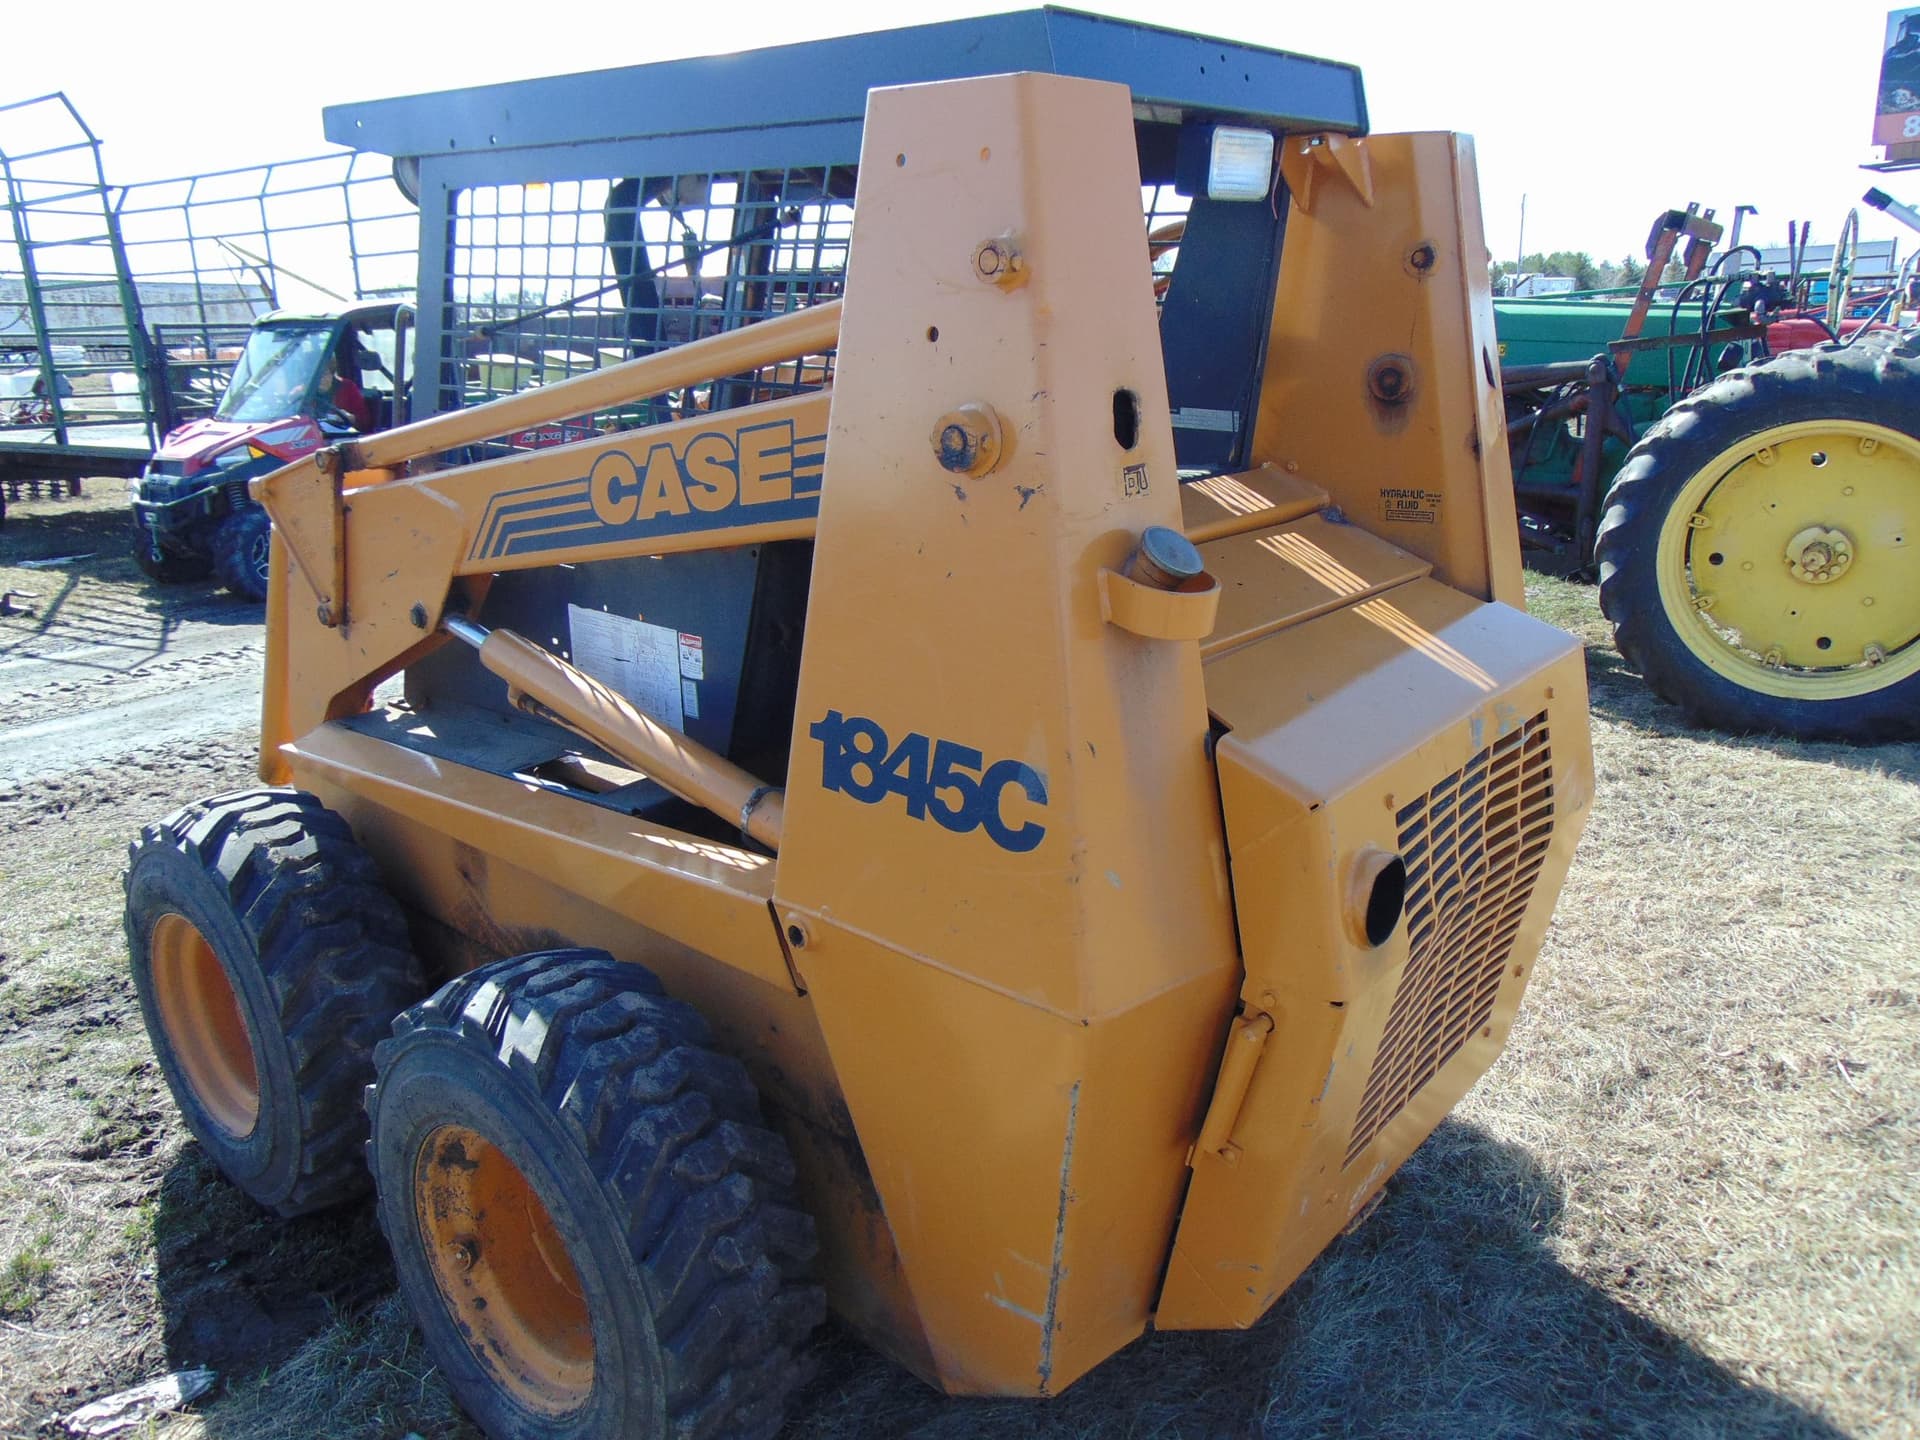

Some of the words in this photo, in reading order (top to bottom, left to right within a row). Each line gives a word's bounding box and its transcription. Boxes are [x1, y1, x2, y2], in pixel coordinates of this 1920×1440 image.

[589, 419, 795, 526] CASE
[1380, 488, 1425, 499] HYDRAULIC
[1397, 500, 1419, 510] FLUID
[809, 709, 1048, 853] 1845C
